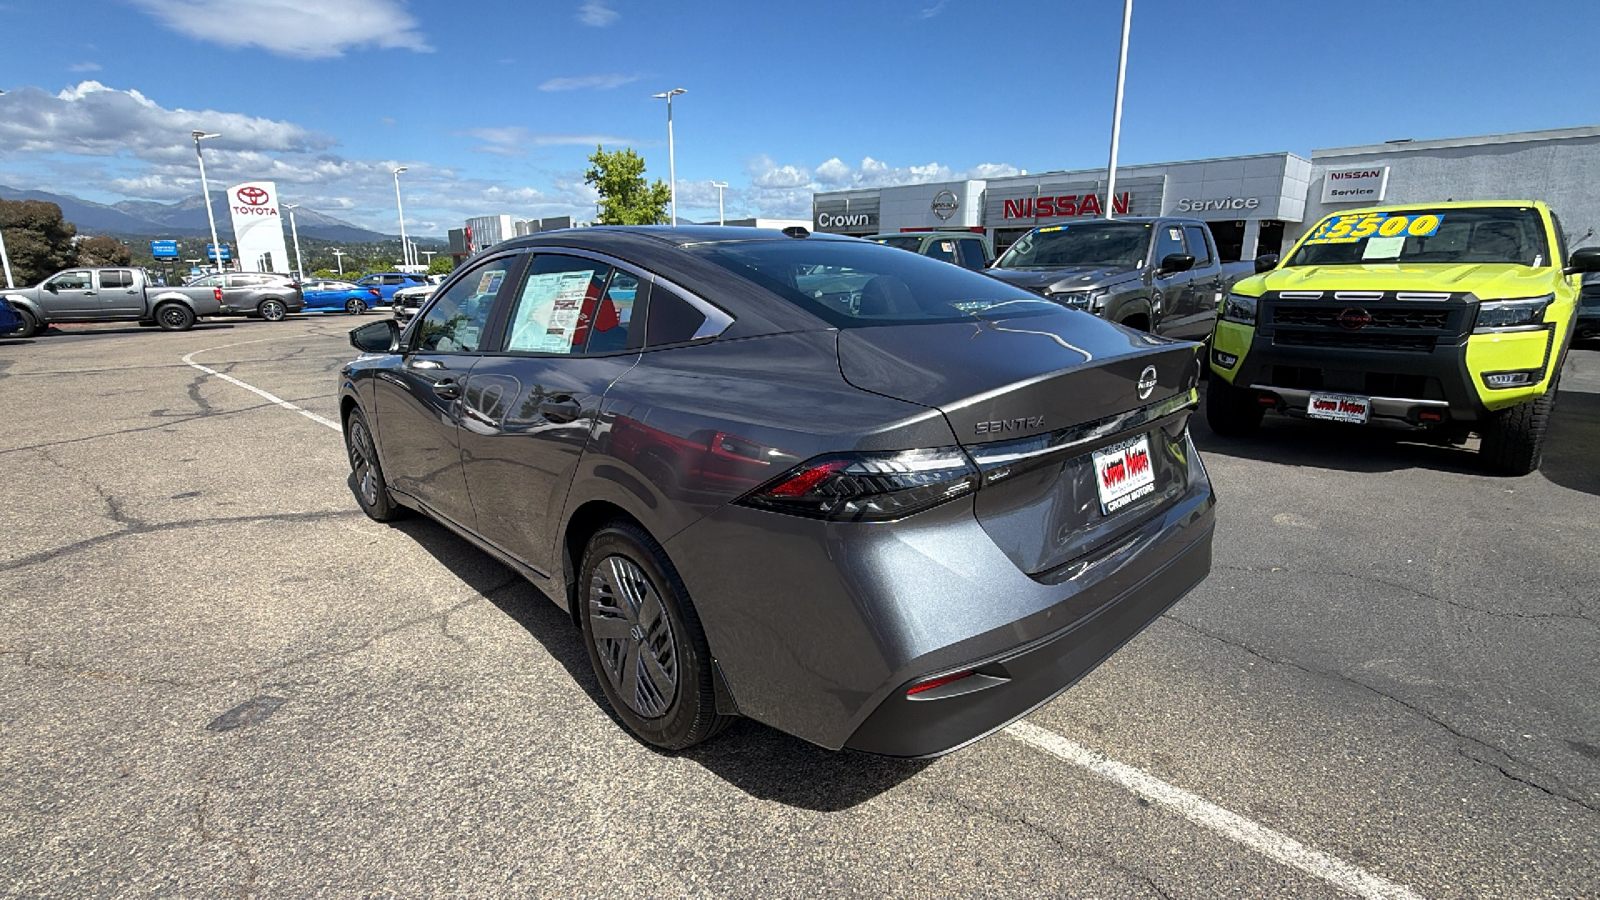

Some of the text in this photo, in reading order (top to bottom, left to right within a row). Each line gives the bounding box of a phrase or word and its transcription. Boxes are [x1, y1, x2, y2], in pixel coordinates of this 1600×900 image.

[1331, 170, 1380, 180] NISSAN
[1331, 188, 1374, 196] Service
[233, 206, 278, 215] TOYOTA
[1003, 191, 1130, 219] NISSAN
[1177, 196, 1259, 212] Service
[818, 212, 869, 227] Crown
[974, 415, 1045, 434] SENTRA
[1107, 494, 1132, 512] CROWN
[1130, 482, 1155, 501] MOTORS
